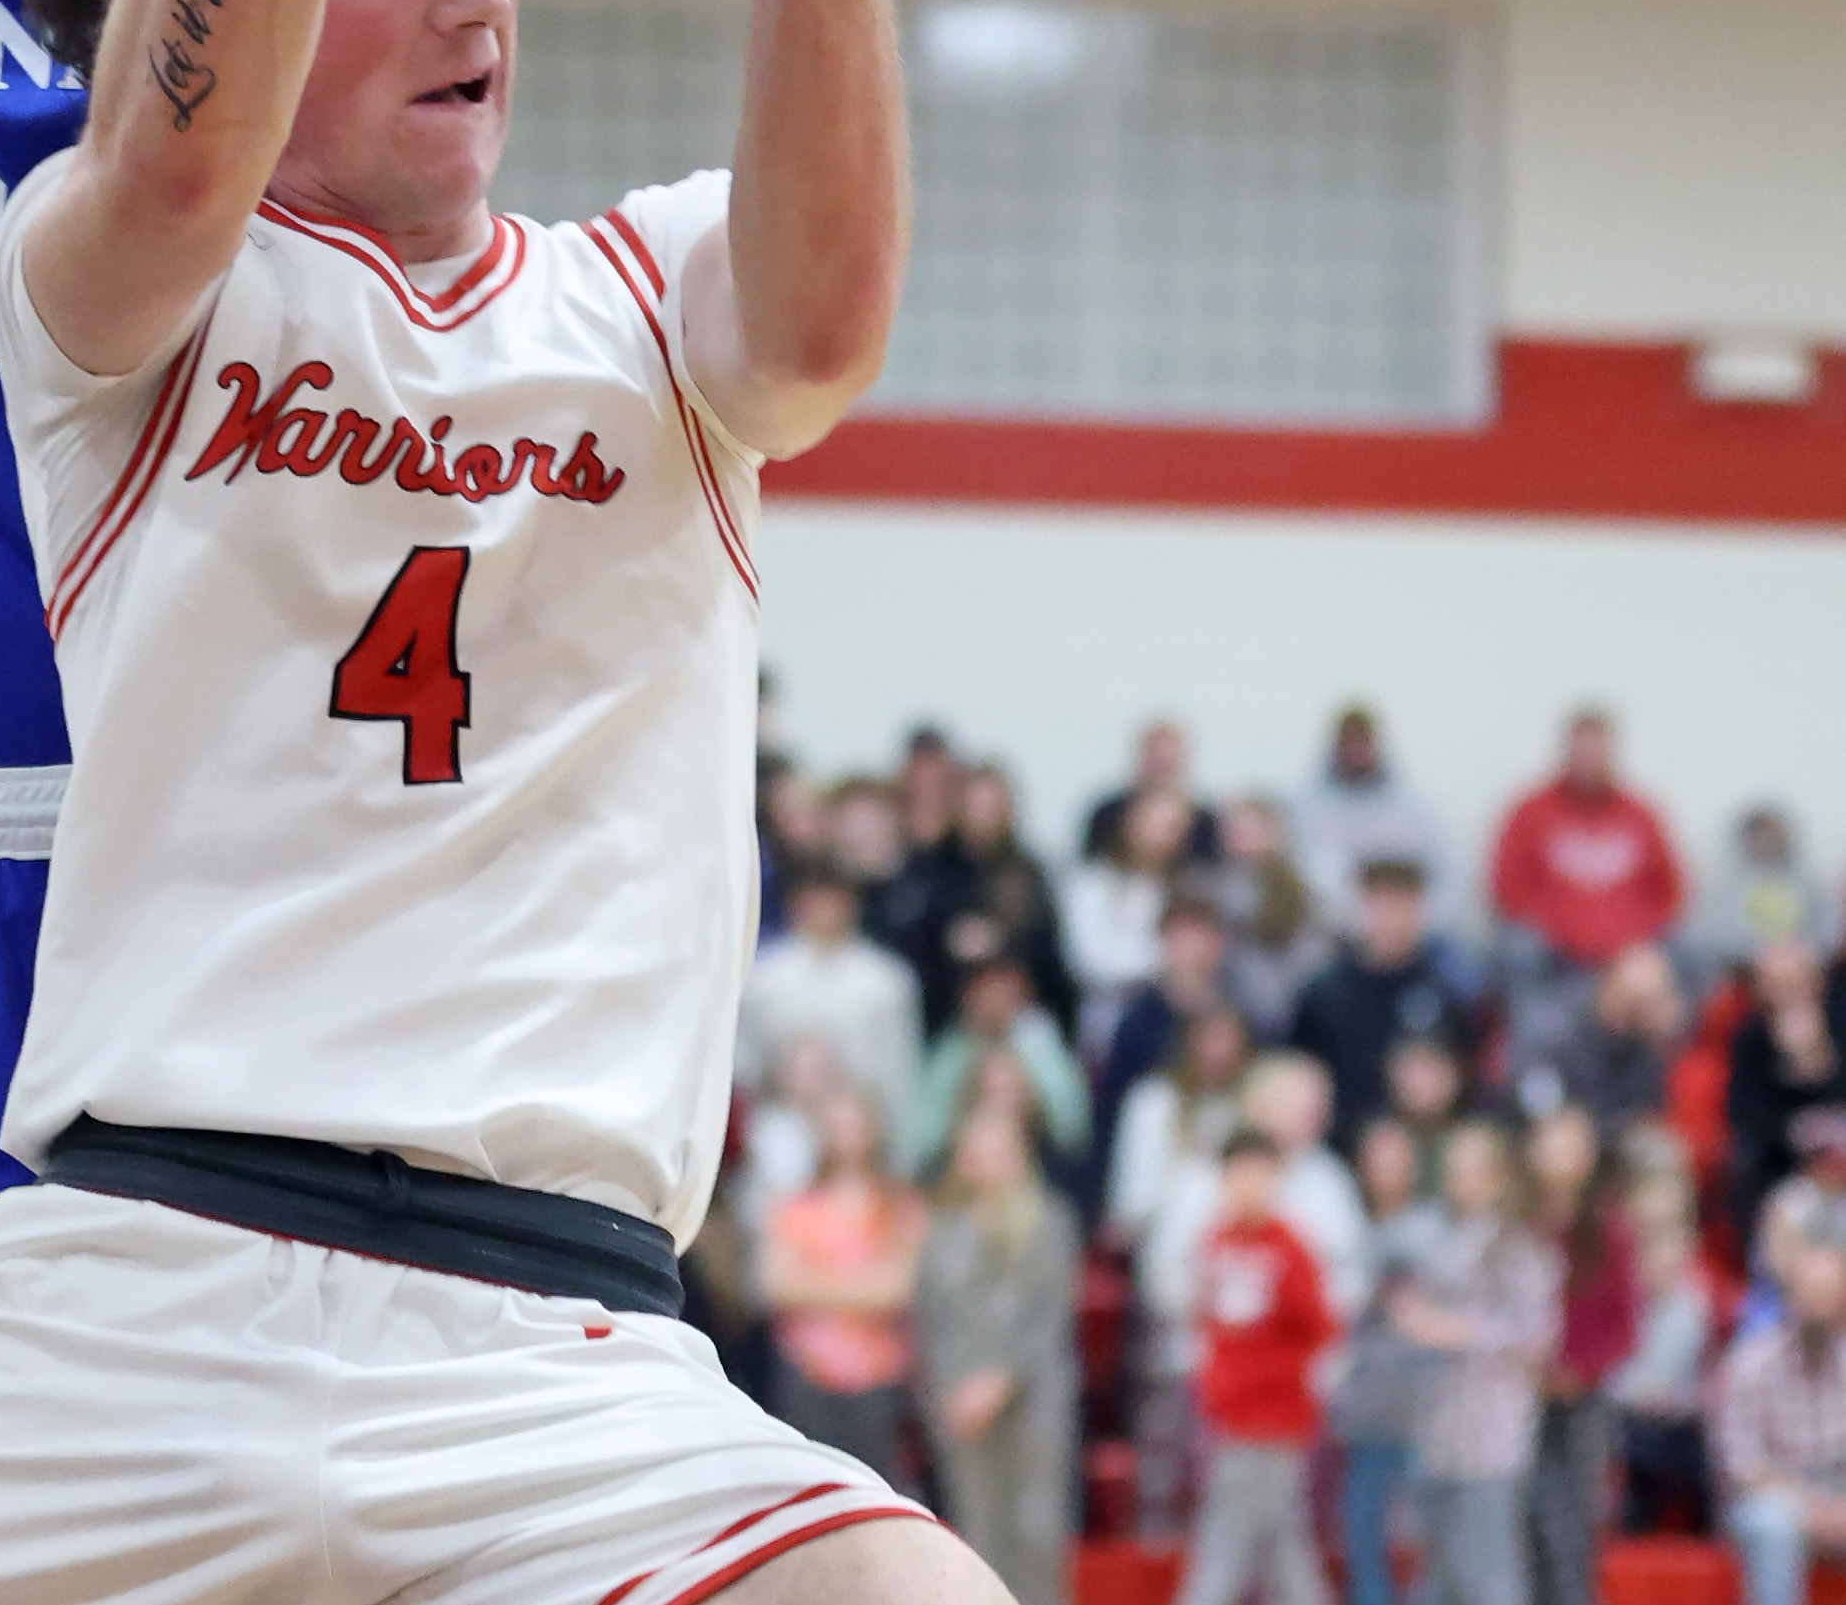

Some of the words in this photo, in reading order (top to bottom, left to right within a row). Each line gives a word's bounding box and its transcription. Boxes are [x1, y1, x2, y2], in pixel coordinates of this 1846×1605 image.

[148, 38, 216, 133] Let
[185, 360, 625, 505] Warriors
[329, 544, 471, 786] 4
